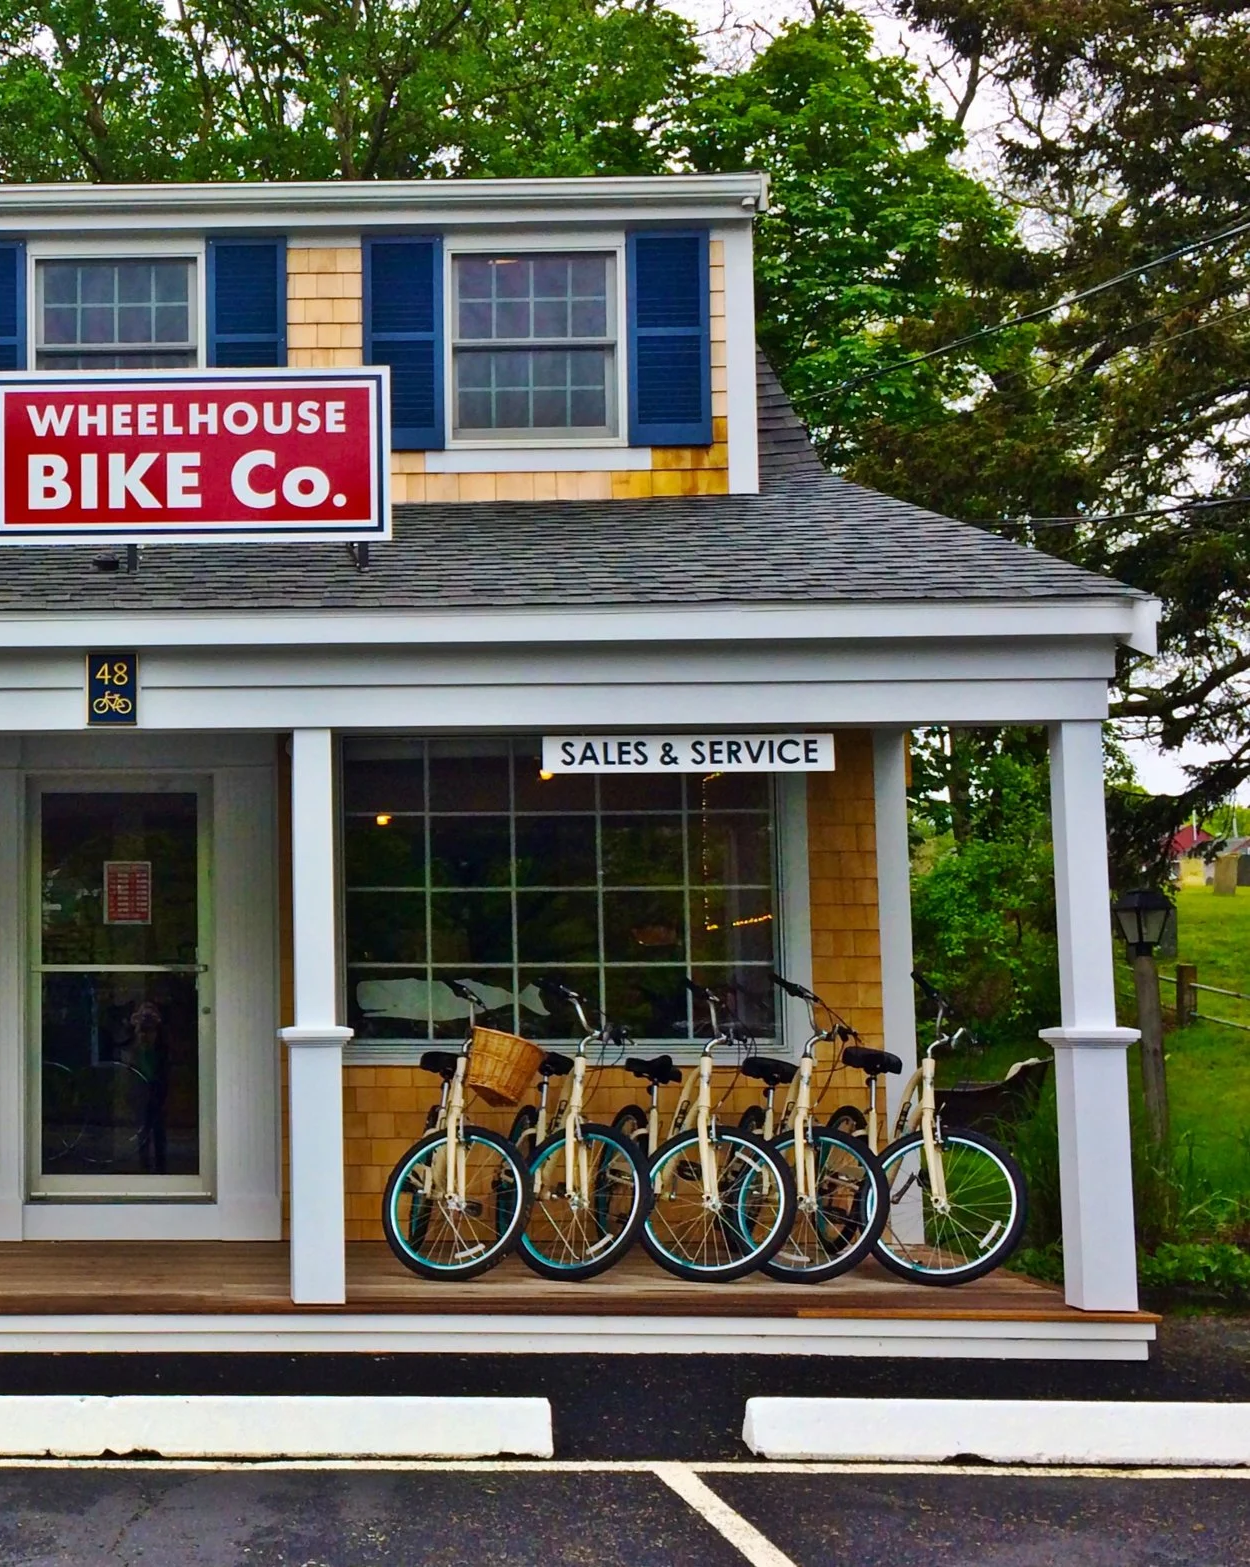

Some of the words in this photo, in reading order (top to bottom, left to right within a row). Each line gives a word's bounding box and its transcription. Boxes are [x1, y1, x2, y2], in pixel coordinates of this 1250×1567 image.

[26, 400, 347, 437] WHEELHOUSE
[27, 451, 202, 510] BIKE
[230, 449, 347, 509] Co.
[95, 662, 128, 686] 48
[560, 740, 649, 766] SALES
[659, 741, 679, 766] &
[690, 738, 818, 765] SERVICE
